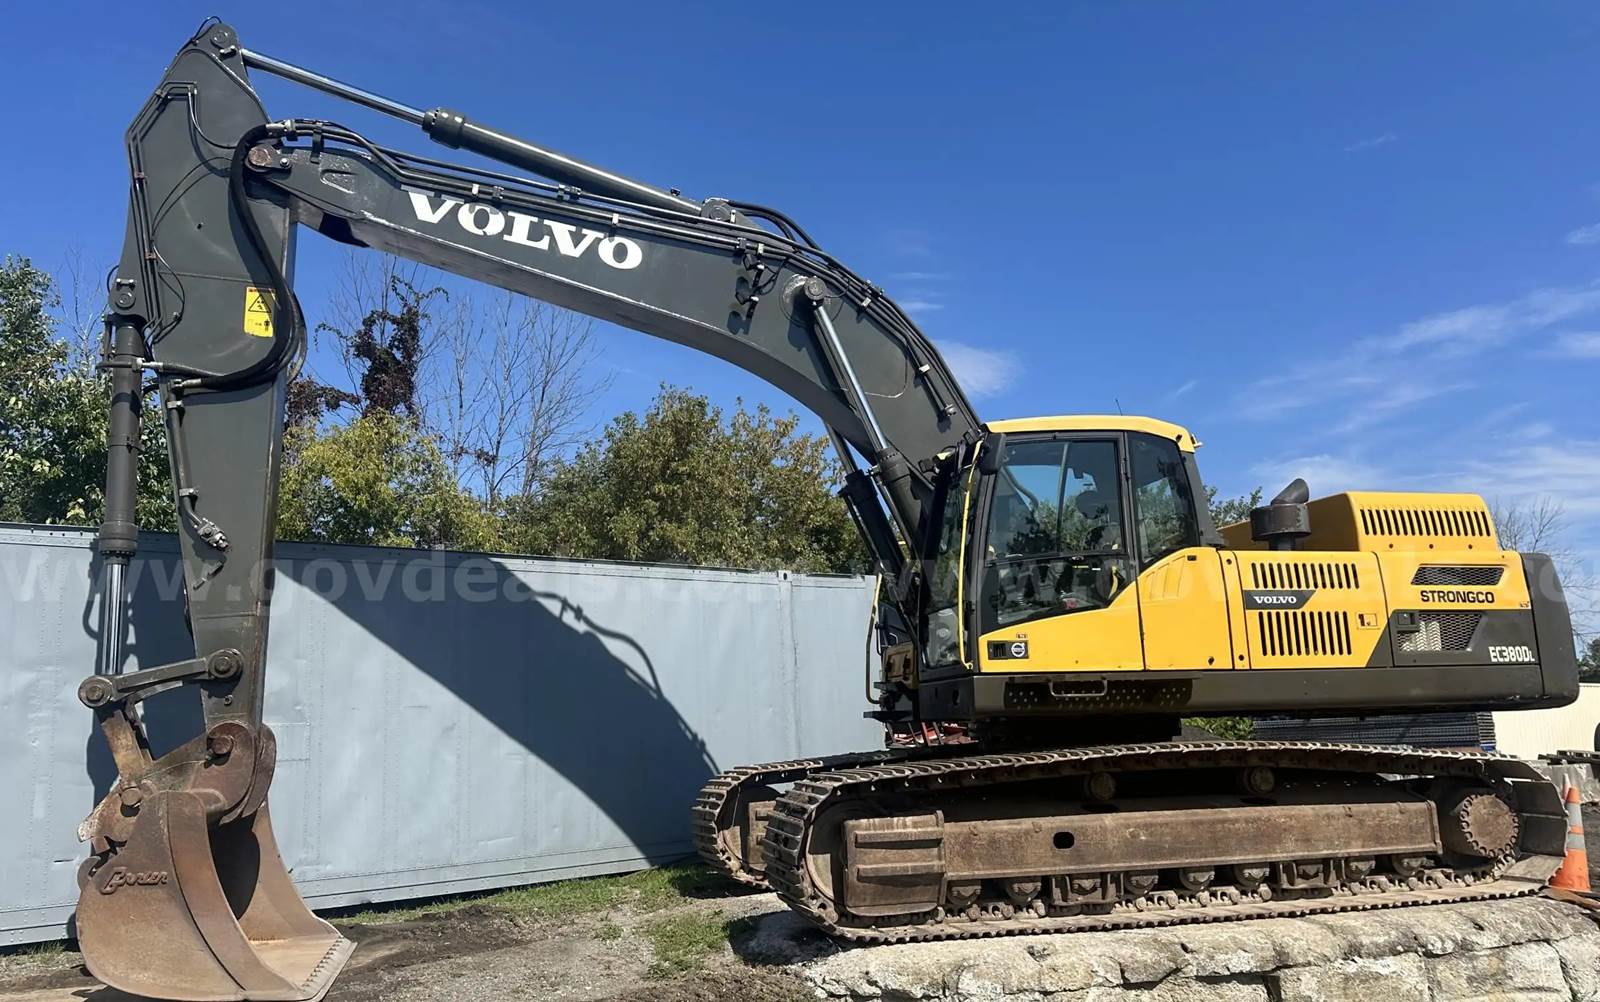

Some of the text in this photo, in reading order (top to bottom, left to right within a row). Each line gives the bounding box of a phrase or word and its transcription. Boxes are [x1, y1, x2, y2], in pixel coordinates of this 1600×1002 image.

[402, 187, 643, 270] VOLVO
[1253, 596, 1297, 604] VOLVO
[1420, 590, 1495, 603] STRONGCO
[1488, 646, 1535, 662] EC380DL
